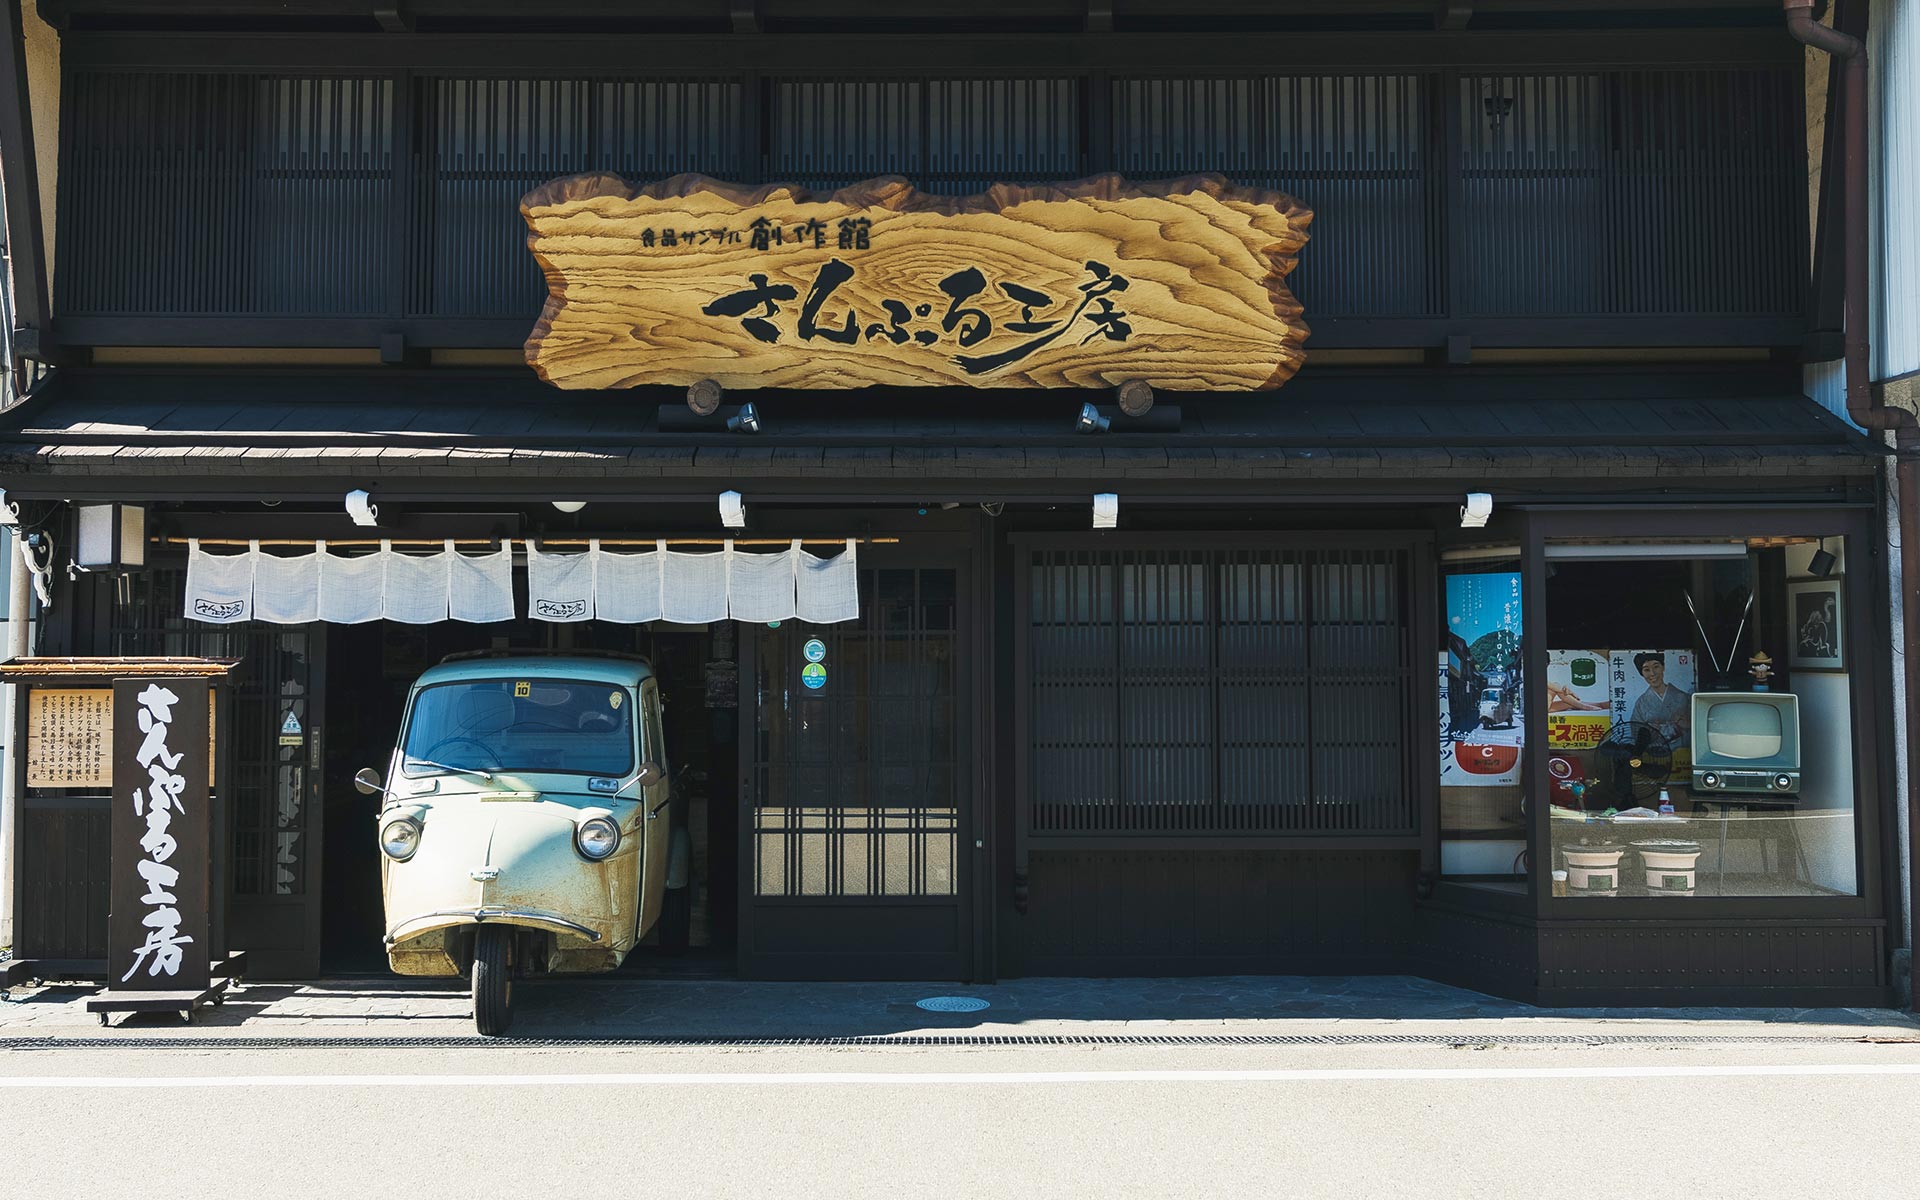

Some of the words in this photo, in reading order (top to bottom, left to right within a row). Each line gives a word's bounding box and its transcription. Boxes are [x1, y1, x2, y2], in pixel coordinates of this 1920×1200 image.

[641, 227, 741, 246] 食品サンプル
[749, 216, 870, 250] 創作館
[702, 260, 1131, 374] さんぷる工房
[1613, 656, 1627, 682] 牛肉
[517, 687, 528, 695] 10
[122, 684, 193, 982] さんぷる工房
